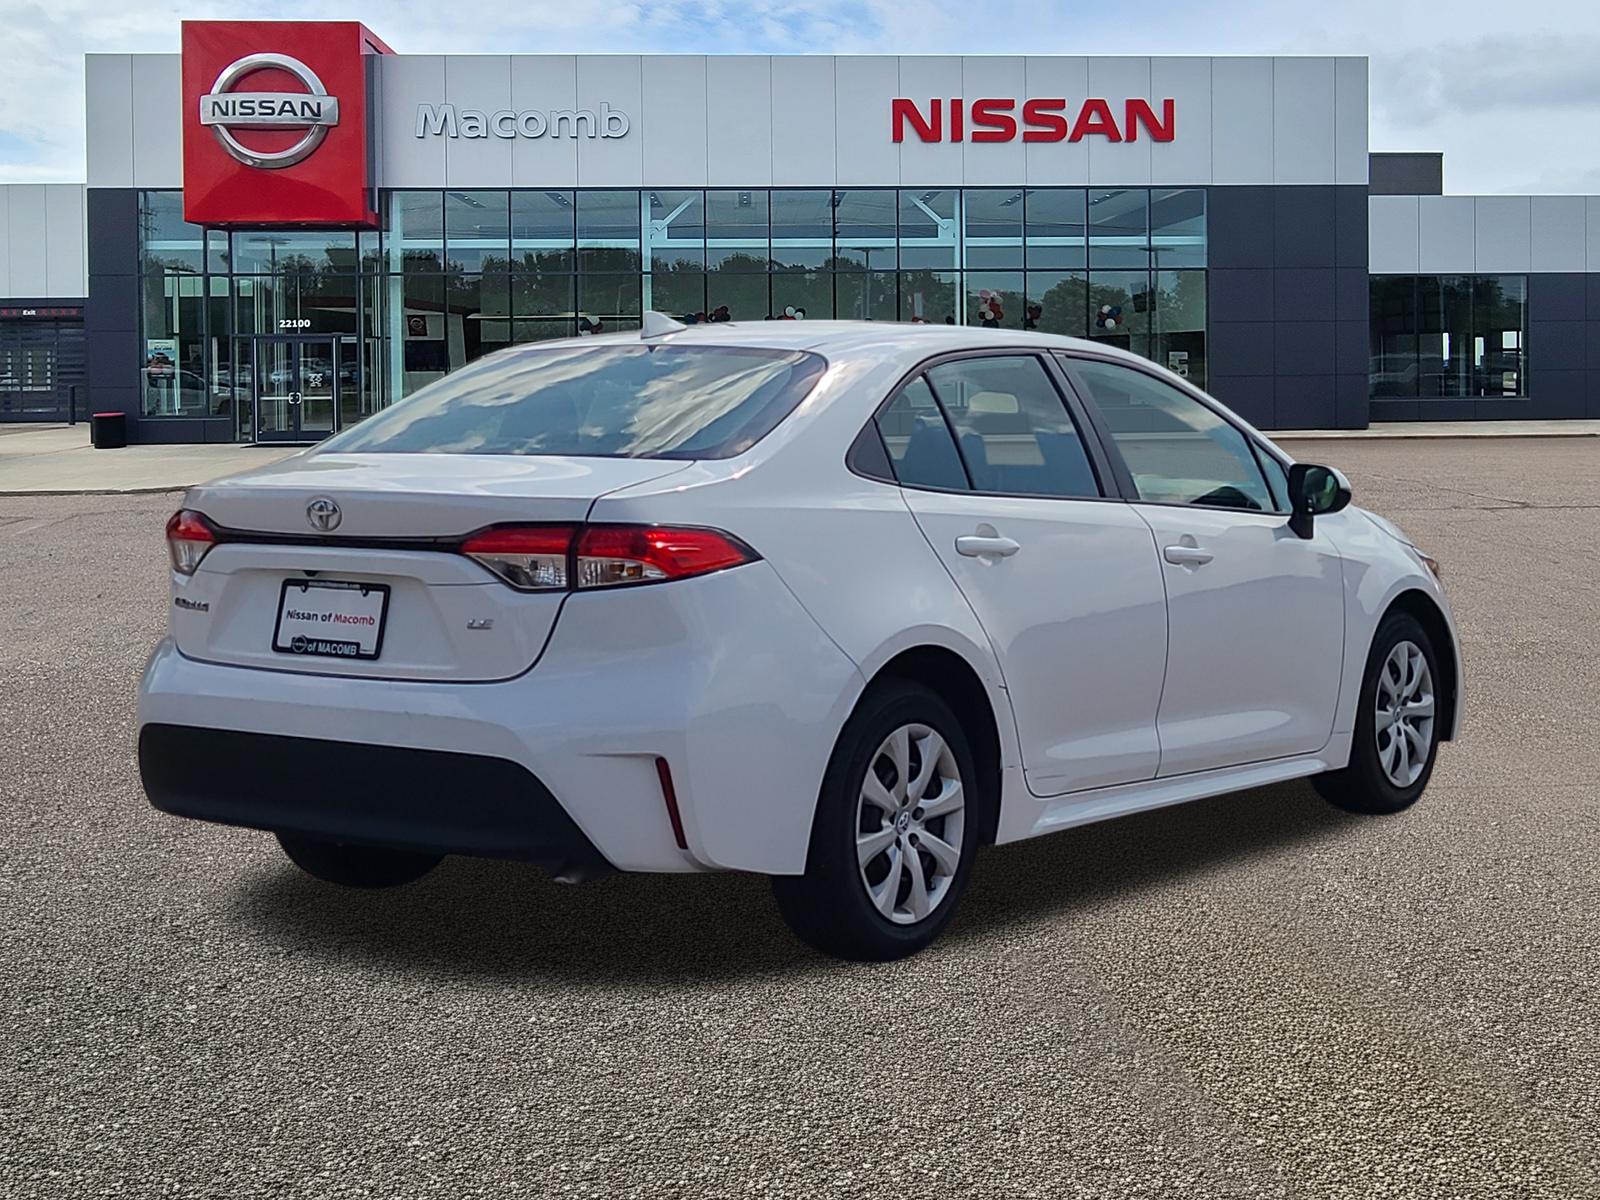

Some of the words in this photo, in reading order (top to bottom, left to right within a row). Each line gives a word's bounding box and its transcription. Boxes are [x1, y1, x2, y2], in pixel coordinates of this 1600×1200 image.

[211, 99, 322, 118] NISSAN
[415, 101, 630, 139] Macomb
[891, 98, 1175, 143] NISSAN
[279, 319, 311, 328] 22100
[286, 609, 318, 621] Nissan
[320, 613, 332, 622] of
[333, 614, 375, 625] Macomb
[307, 642, 316, 652] of
[317, 642, 357, 655] MACOMB
